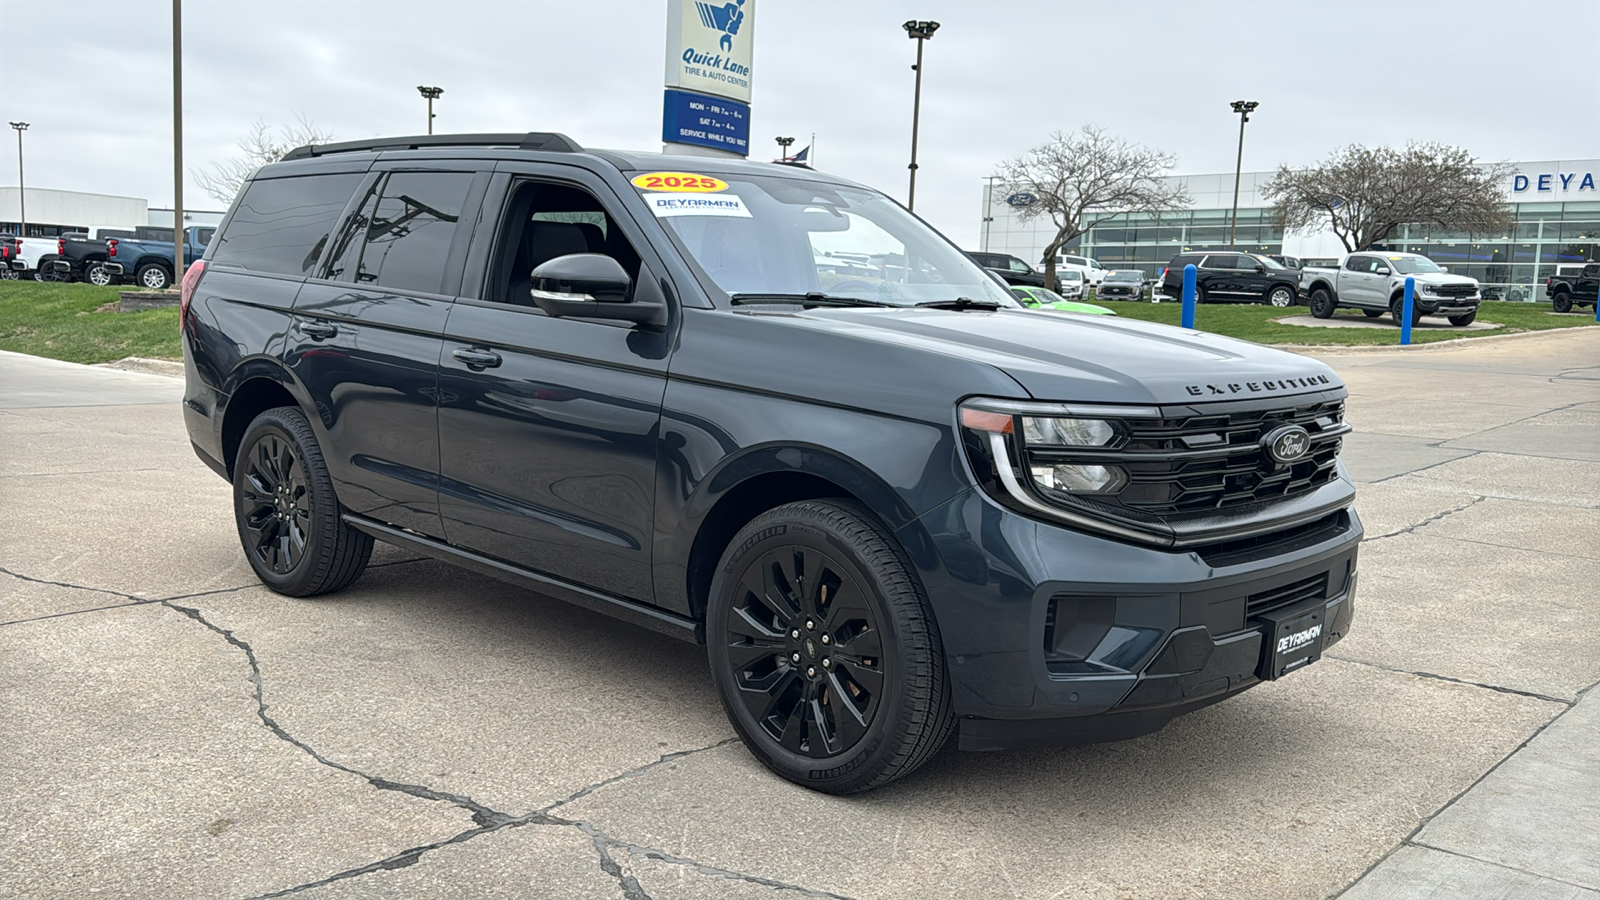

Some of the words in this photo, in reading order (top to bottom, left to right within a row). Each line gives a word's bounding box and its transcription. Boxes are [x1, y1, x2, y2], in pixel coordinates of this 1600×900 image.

[682, 48, 722, 68] Quick
[722, 57, 749, 77] Lane
[685, 66, 700, 76] TIRE
[708, 71, 726, 82] AUTO
[727, 76, 748, 87] CENTER
[689, 102, 704, 111] MON
[711, 105, 720, 114] FRI
[699, 117, 710, 125] SAT
[680, 128, 706, 139] SERVICE
[707, 132, 724, 142] WHILE
[726, 136, 735, 144] YOU
[645, 176, 717, 189] 2025
[656, 199, 739, 208] DEYARMAN
[1185, 375, 1330, 396] EXPEDITION
[1281, 433, 1304, 456] Ford
[735, 526, 785, 559] MICHELIN
[1277, 624, 1322, 653] DEYARMAN
